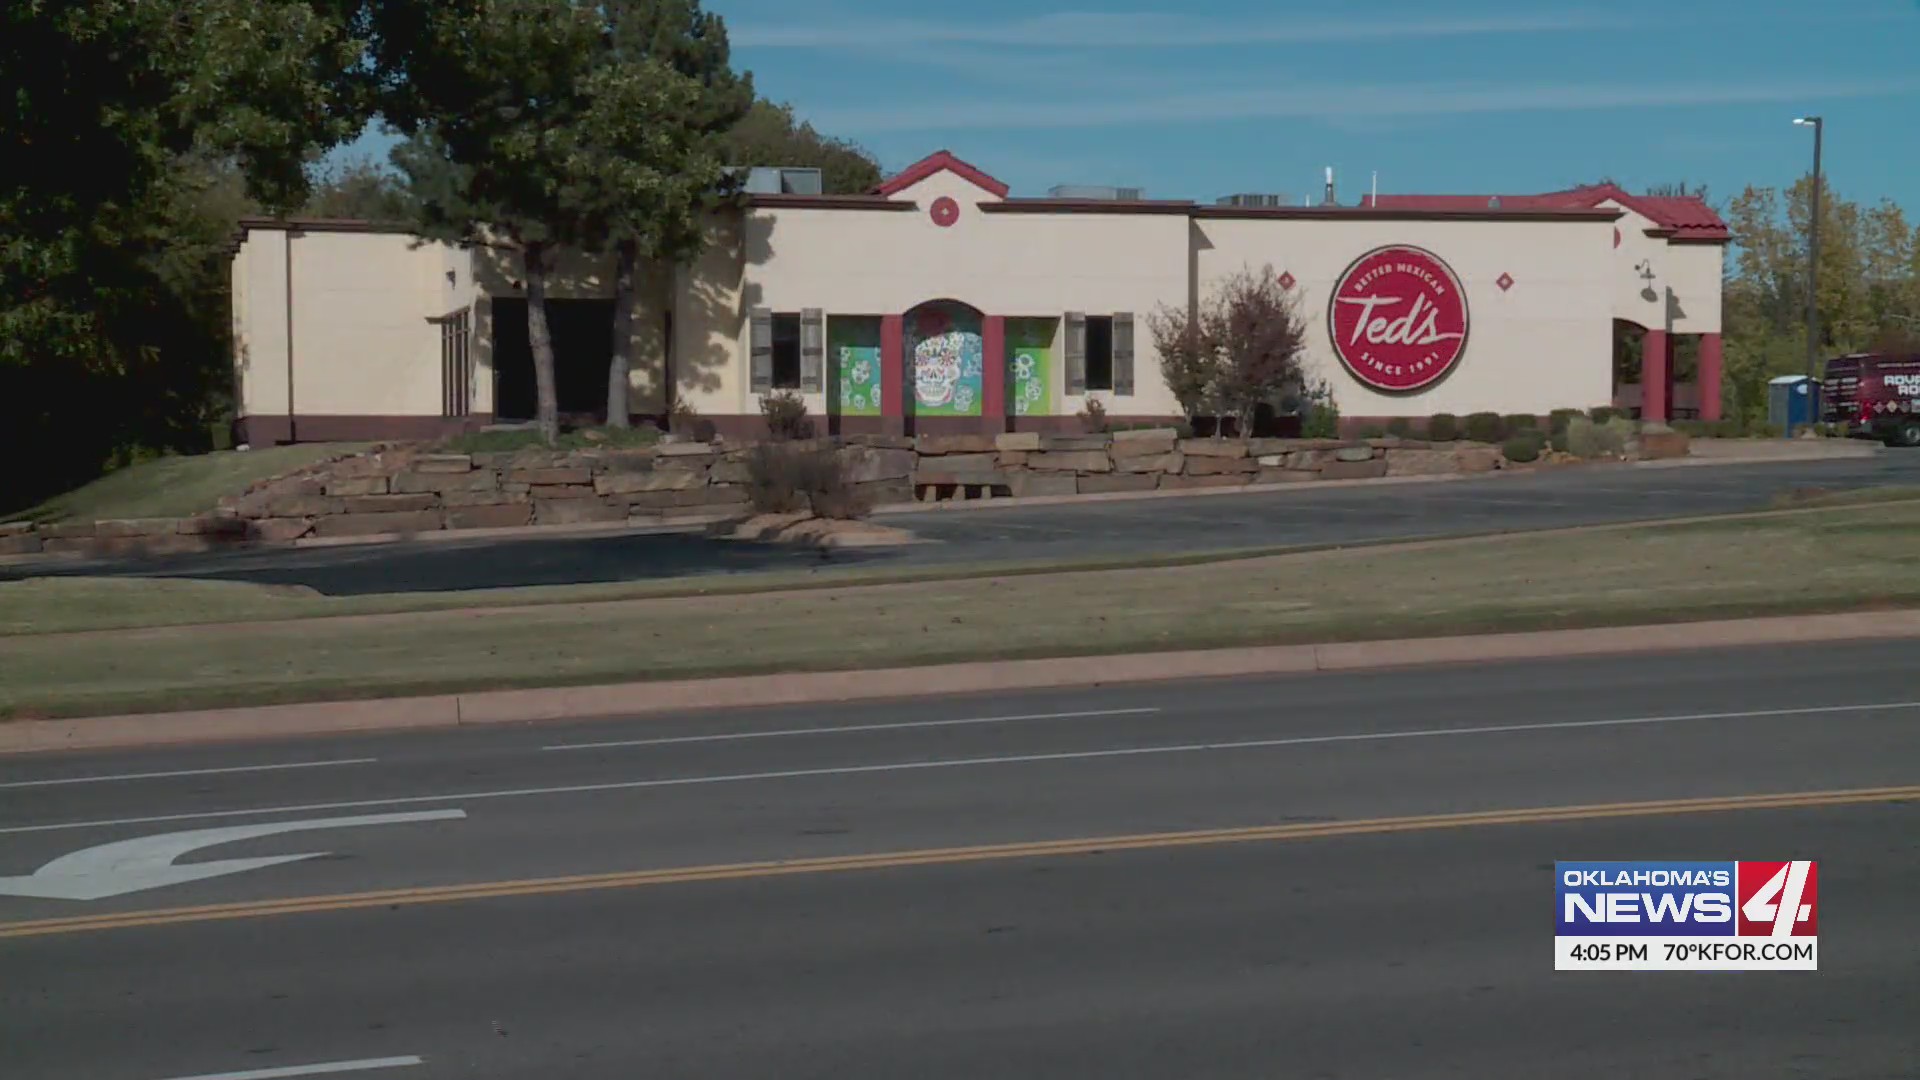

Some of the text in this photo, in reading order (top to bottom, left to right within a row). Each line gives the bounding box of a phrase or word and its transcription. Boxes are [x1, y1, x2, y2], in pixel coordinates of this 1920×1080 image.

[1354, 263, 1446, 296] BETTER MEXICAN
[1336, 291, 1464, 347] Ted's
[1360, 352, 1440, 375] SINCE 1991
[1898, 385, 1920, 395] RO
